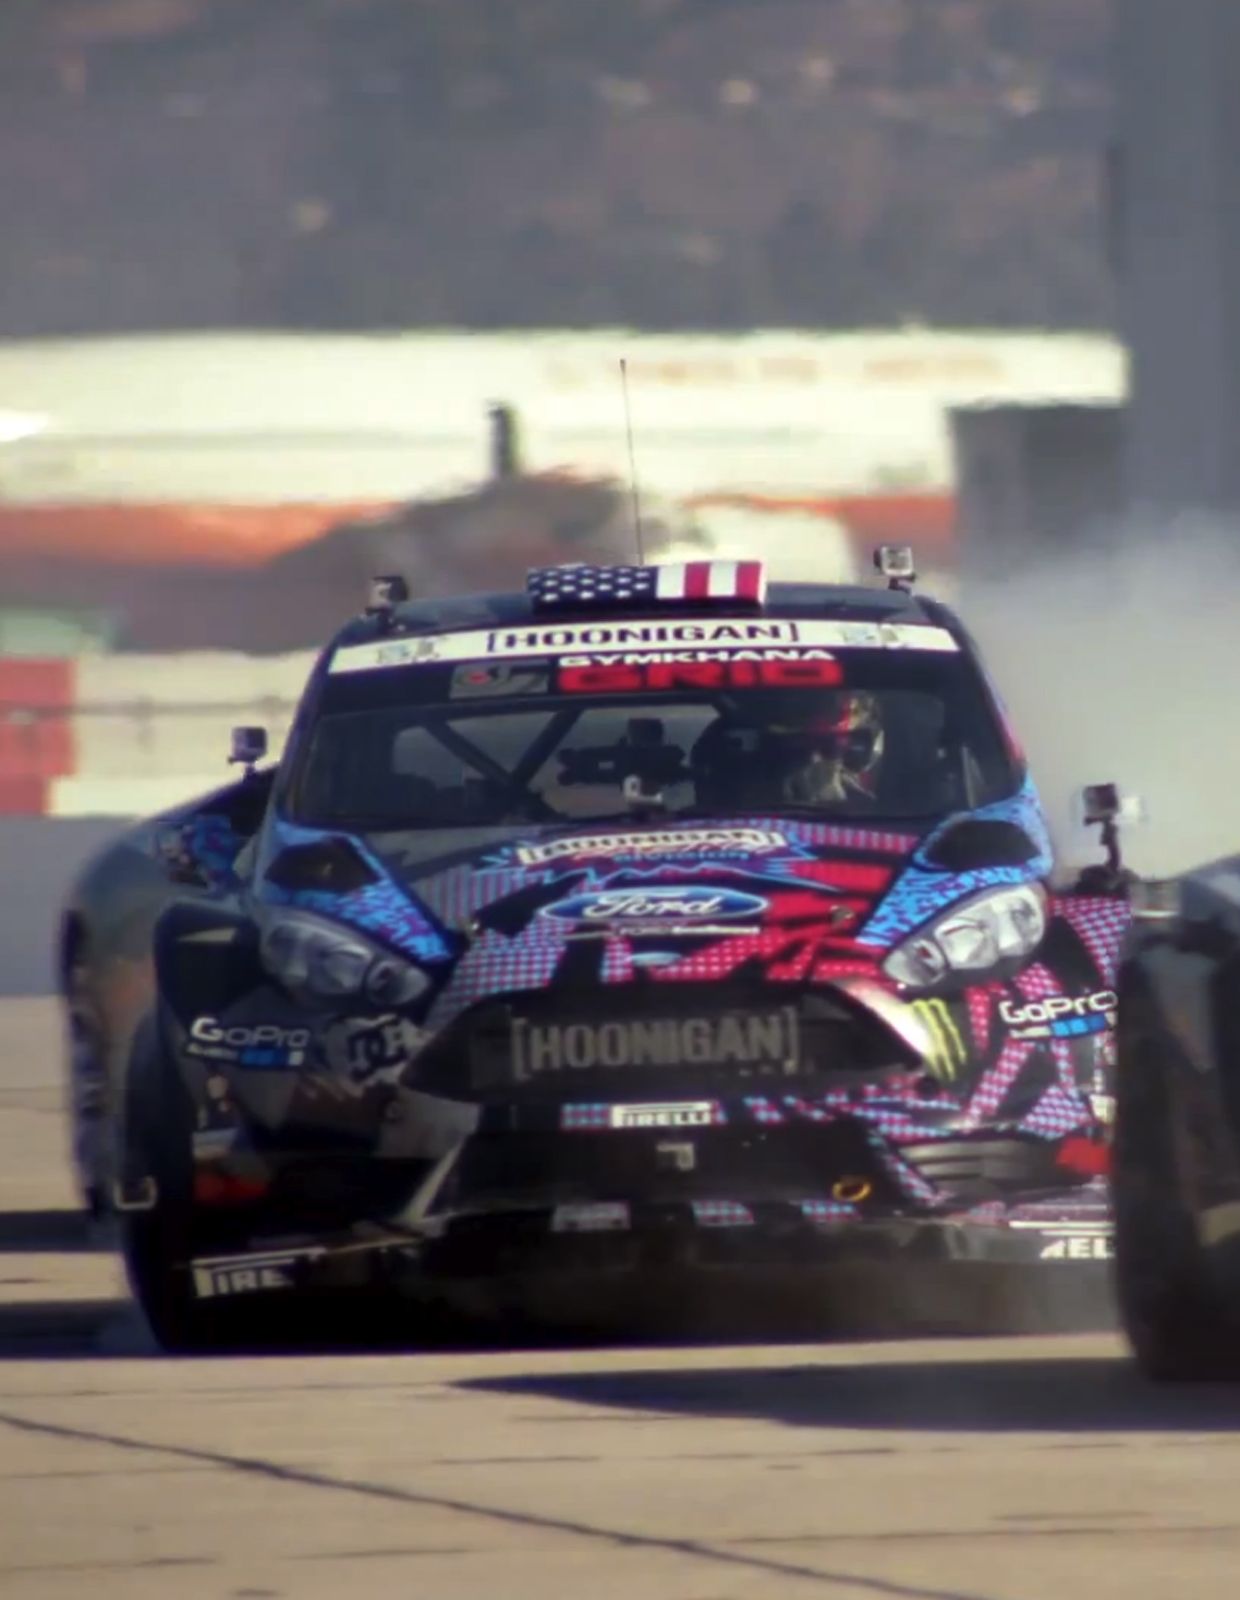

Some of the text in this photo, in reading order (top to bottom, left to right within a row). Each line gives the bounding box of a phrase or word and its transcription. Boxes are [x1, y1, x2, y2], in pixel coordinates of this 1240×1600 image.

[488, 622, 799, 653] [HOONIGAN]
[558, 649, 835, 667] GYMKHANA
[557, 661, 843, 693] GRID
[583, 896, 723, 918] Ford
[999, 991, 1118, 1023] GoPro
[190, 1017, 310, 1048] GoPro
[511, 1006, 799, 1081] [HOONIGAN]
[611, 1101, 712, 1128] PIRELLI
